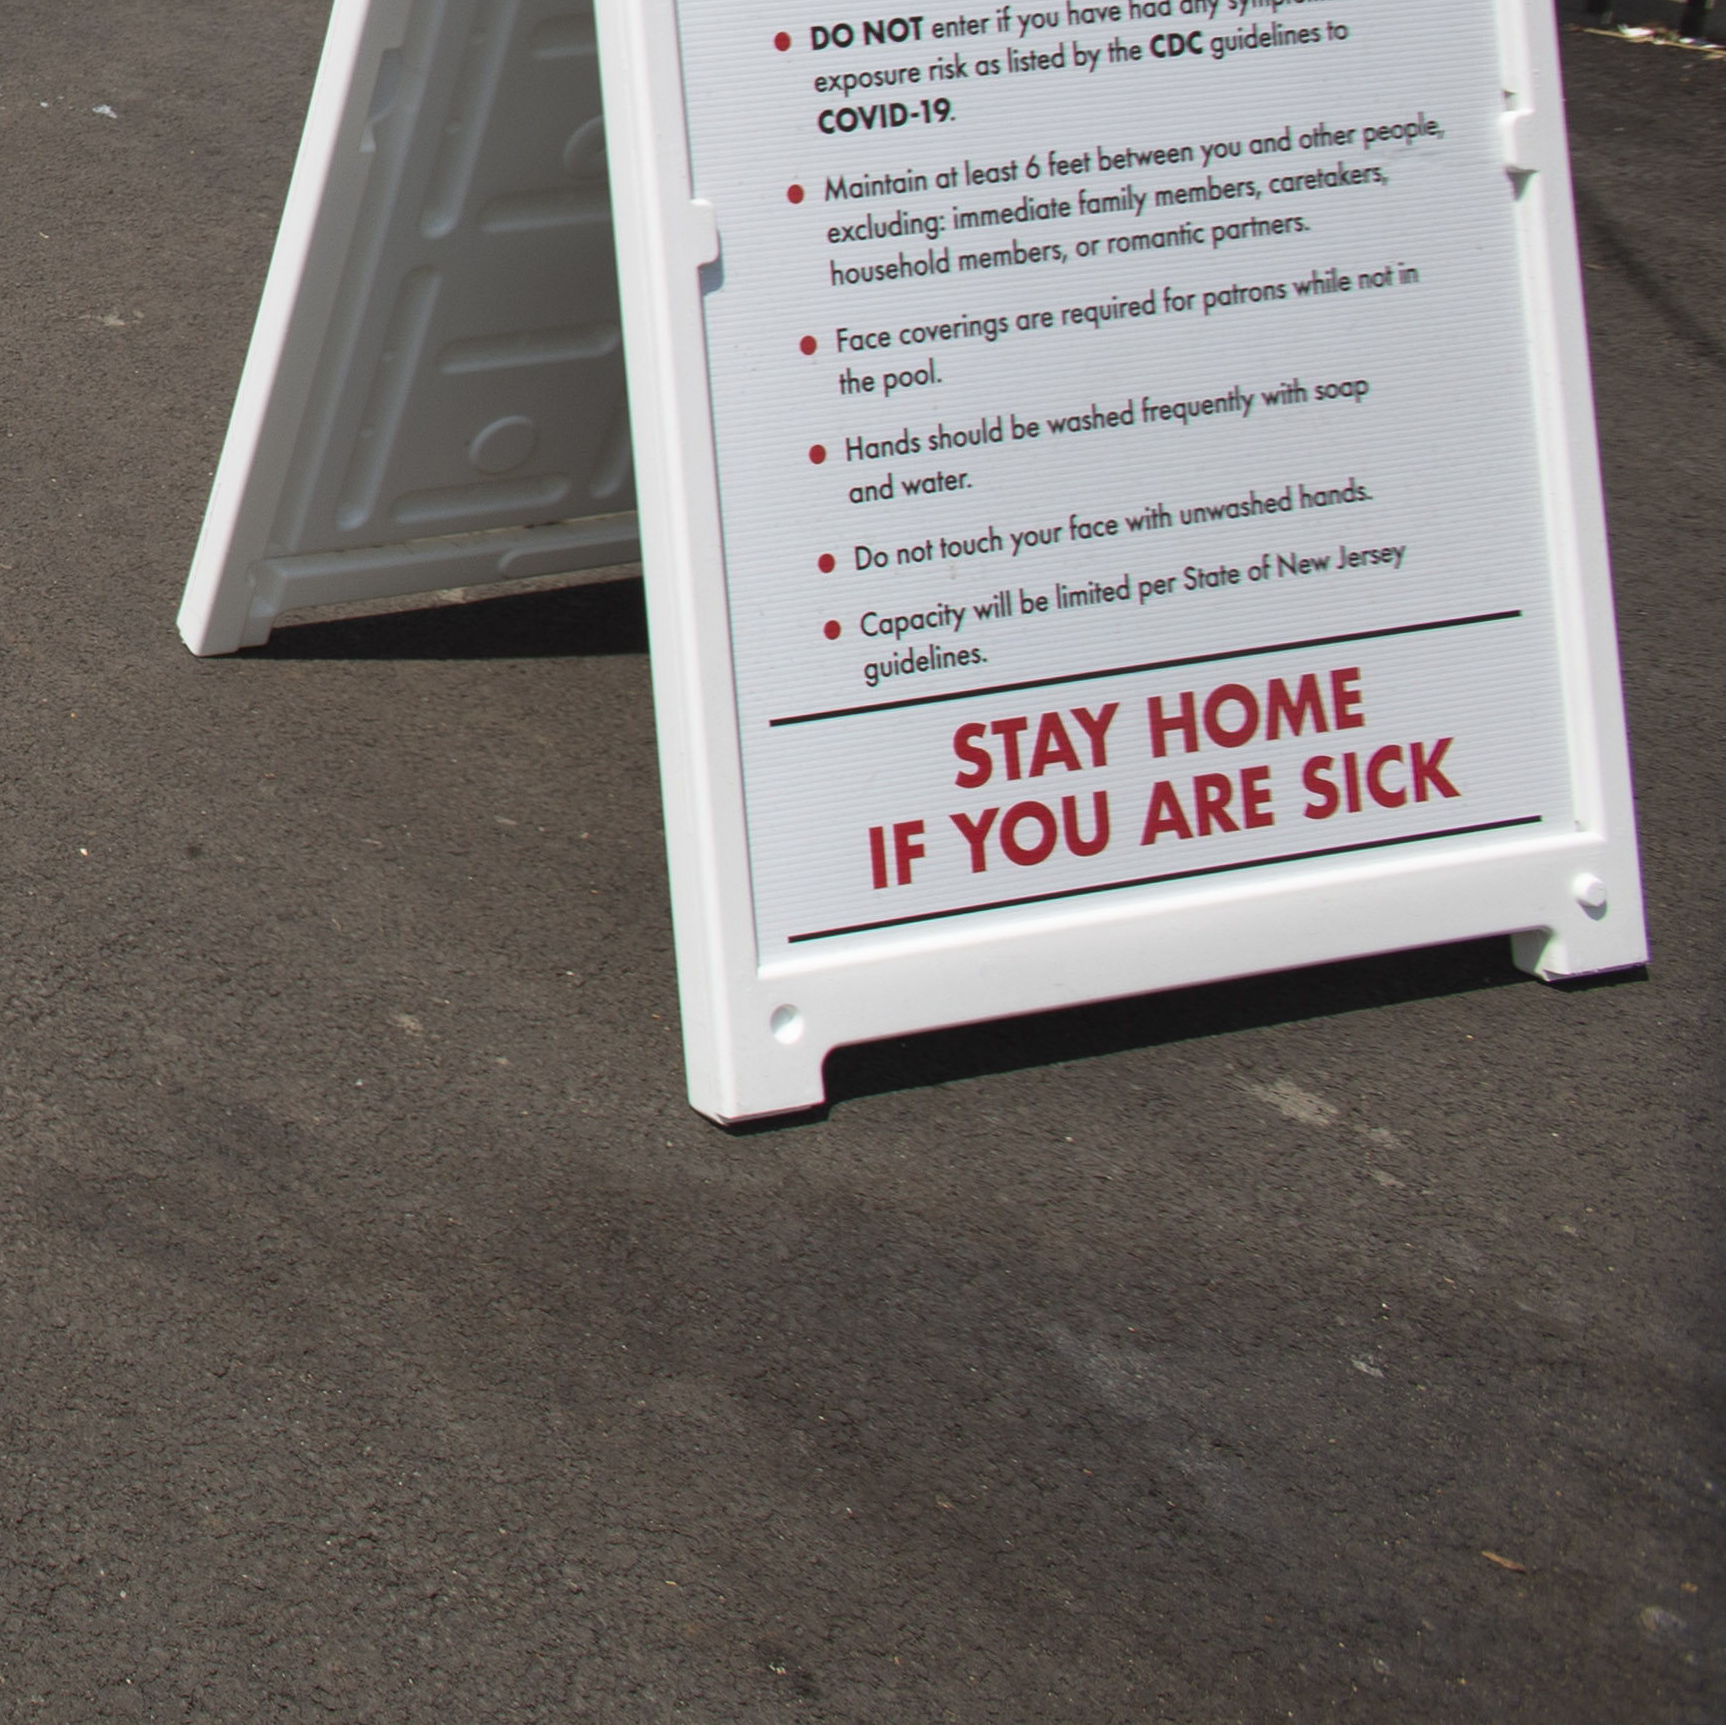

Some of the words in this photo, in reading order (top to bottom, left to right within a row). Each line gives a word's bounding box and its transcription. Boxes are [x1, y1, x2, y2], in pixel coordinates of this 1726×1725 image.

[811, 23, 854, 50] DO
[863, 16, 923, 45] NOT
[932, 15, 990, 38] enter
[996, 6, 1011, 33] if
[1017, 5, 1060, 39] you
[1067, 0, 1121, 25] have
[815, 67, 920, 98] exposure
[930, 53, 968, 81] risk
[976, 59, 1000, 76] as
[1007, 42, 1065, 73] listed
[1073, 41, 1100, 72] by
[1108, 37, 1142, 62] the
[1150, 31, 1203, 58] CDC
[1211, 25, 1321, 61] guidelines
[1326, 21, 1349, 43] to
[818, 98, 955, 134] COVID-19.
[825, 169, 927, 201] Maintain
[936, 167, 958, 189] at
[965, 160, 1018, 185] least
[1026, 155, 1040, 179] 6
[1049, 150, 1091, 176] feet
[1098, 146, 1193, 171] between
[1201, 142, 1241, 167] you
[1250, 126, 1291, 154] and
[1299, 122, 1356, 149] other
[1364, 112, 1444, 150] people,
[828, 210, 945, 243] excluding:
[953, 196, 1071, 229] immediate
[1079, 184, 1147, 216] family
[1156, 175, 1261, 206] members,
[1269, 161, 1387, 193] caretakers,
[831, 247, 950, 286] household
[959, 239, 1067, 271] members,
[1076, 240, 1100, 257] or
[1108, 222, 1204, 253] romantic
[1212, 217, 1310, 249] partners.
[837, 328, 891, 352] Face
[900, 314, 1008, 345] coverings
[1017, 312, 1053, 330] are
[1062, 289, 1156, 329] required
[1164, 287, 1196, 312] for
[1203, 284, 1287, 316] patrons
[1293, 268, 1351, 295] while
[1359, 265, 1393, 290] not
[1398, 262, 1420, 286] in
[840, 368, 874, 394] the
[884, 358, 942, 397] pool.
[846, 428, 921, 461] Hands
[929, 416, 1003, 451] should
[1011, 414, 1039, 439] be
[1047, 399, 1134, 434] washed
[1142, 385, 1254, 425] frequently
[1262, 378, 1307, 405] with
[1315, 380, 1369, 403] soap
[849, 473, 893, 503] and
[902, 471, 972, 495] water.
[855, 546, 888, 570] Do
[898, 540, 933, 564] not
[940, 526, 1002, 558] touch
[1010, 527, 1062, 556] your
[1070, 514, 1118, 540] face
[1125, 503, 1172, 531] with
[1181, 486, 1292, 525] unwashed
[1299, 477, 1373, 508] hands.
[861, 603, 966, 640] Capacity
[973, 590, 1012, 620] will
[1020, 588, 1048, 614] be
[1056, 574, 1130, 609] limited
[1139, 577, 1176, 605] per
[1184, 566, 1240, 590] State
[1248, 554, 1271, 581] of
[1278, 553, 1330, 577] New
[1337, 546, 1405, 569] Jersey
[865, 644, 988, 687] guidelines.
[953, 702, 1119, 788] STAY
[1147, 667, 1364, 758] HOME
[869, 820, 925, 889] IF
[949, 790, 1110, 873] YOU
[1140, 765, 1274, 846] ARE
[1302, 737, 1461, 819] SICK
